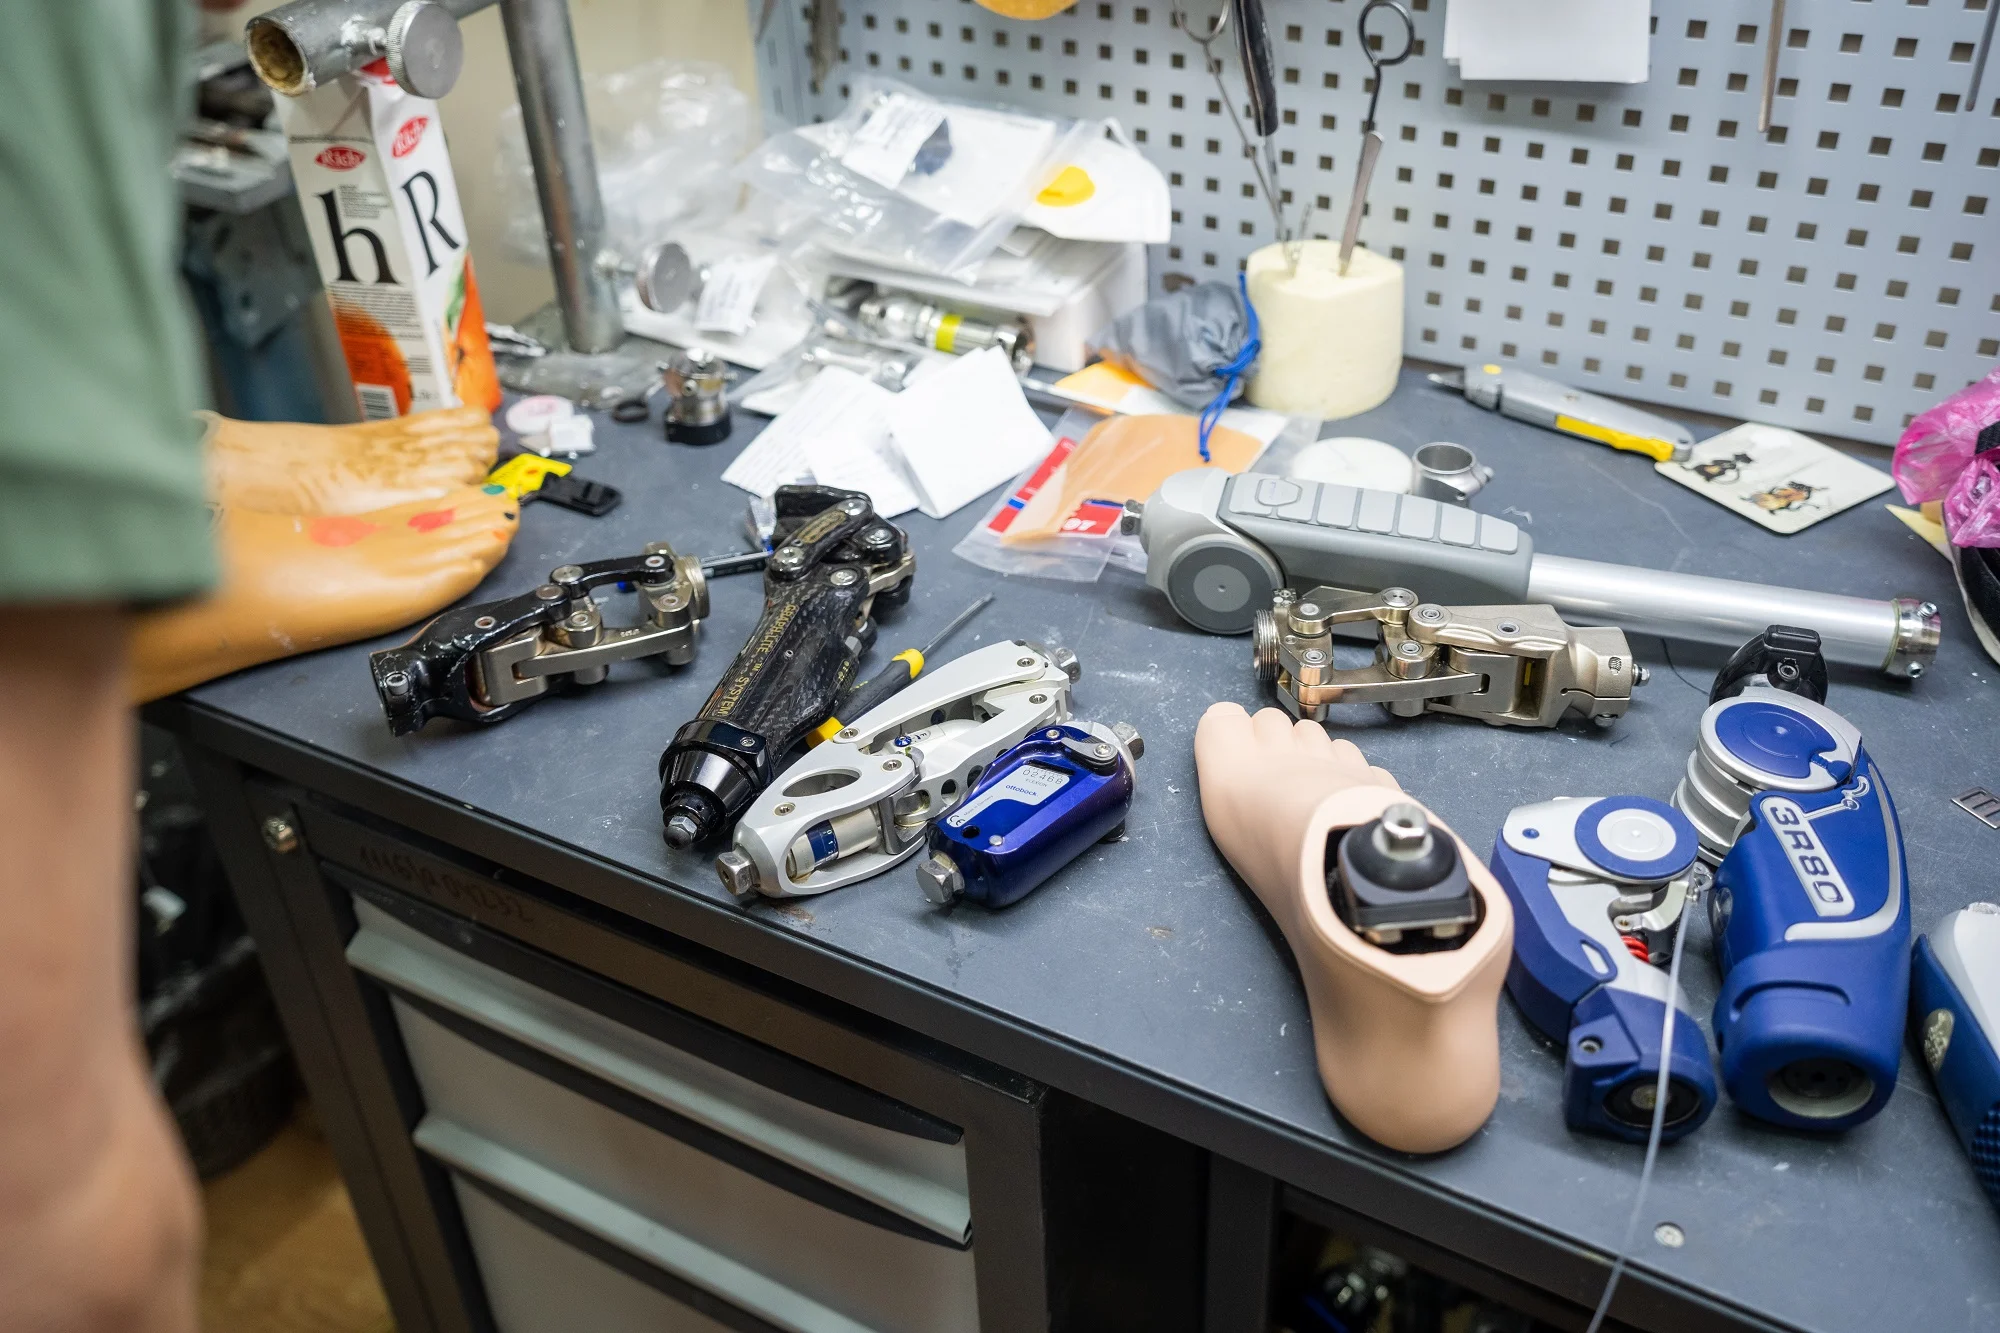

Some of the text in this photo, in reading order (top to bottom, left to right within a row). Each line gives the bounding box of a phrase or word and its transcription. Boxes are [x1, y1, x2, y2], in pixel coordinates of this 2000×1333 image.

[312, 189, 401, 285] h
[401, 170, 460, 280] R
[717, 675, 751, 717] SYSTEM
[1770, 805, 1845, 904] 3R80
